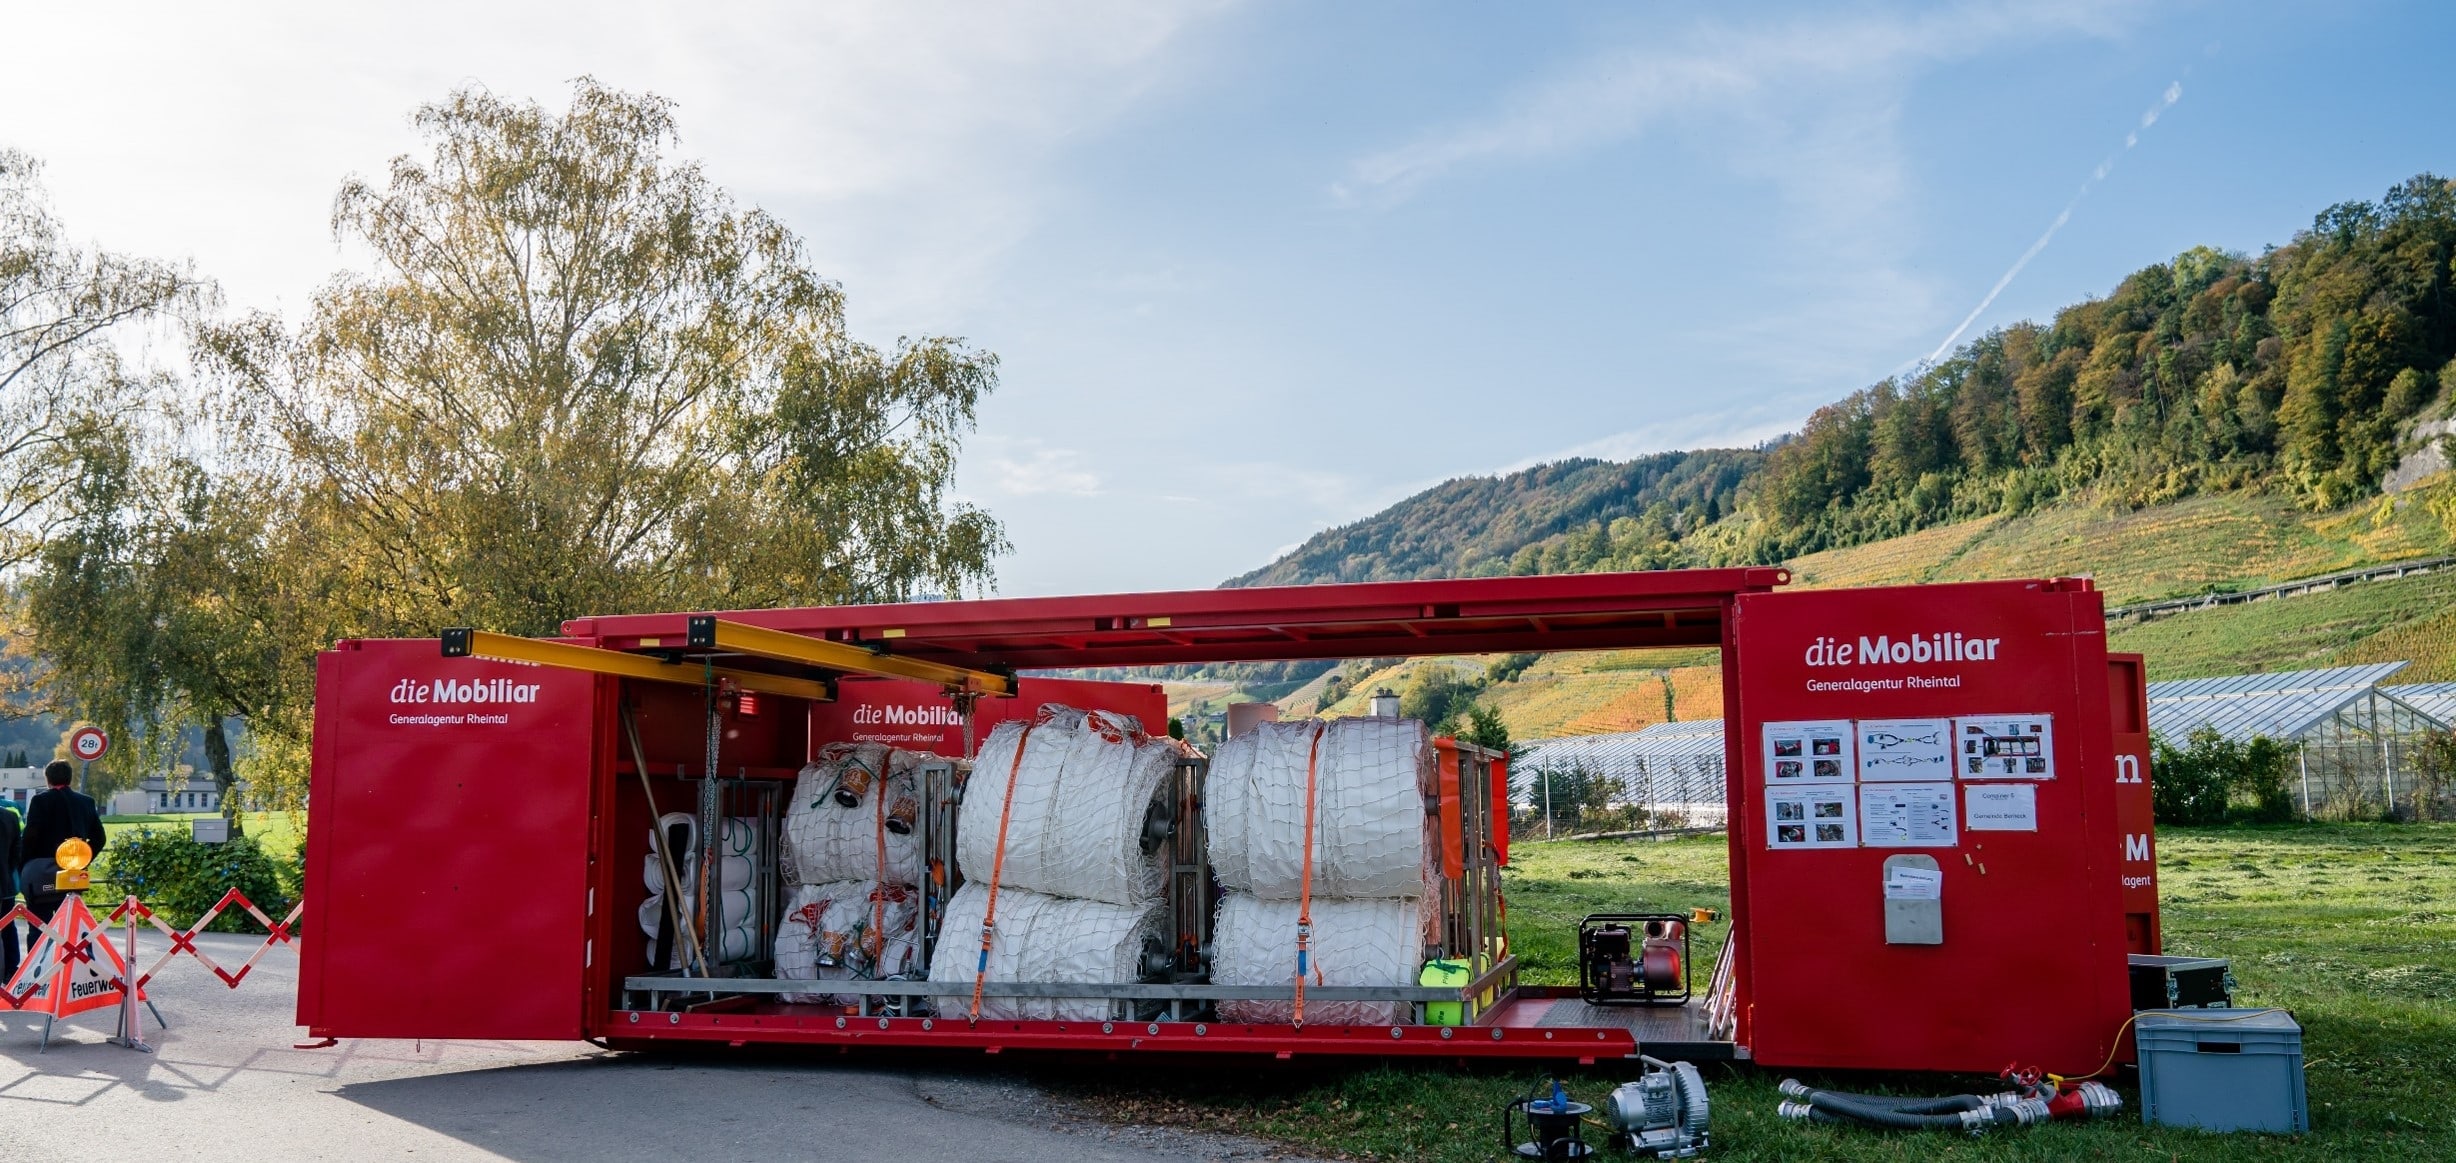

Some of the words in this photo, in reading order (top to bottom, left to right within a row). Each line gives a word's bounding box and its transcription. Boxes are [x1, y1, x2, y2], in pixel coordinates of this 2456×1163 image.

[1804, 636, 1853, 666] die
[1858, 632, 2000, 664] Mobiliar
[390, 678, 430, 703] die
[432, 678, 540, 703] Mobiliar
[1806, 677, 1904, 693] Generalagentur
[1906, 675, 1961, 689] Rheintal
[389, 713, 465, 727] Generalagentur
[466, 713, 508, 725] Rheintal
[853, 703, 882, 724] die
[852, 731, 911, 743] Generalagentur
[71, 975, 123, 999] Feuerwe
